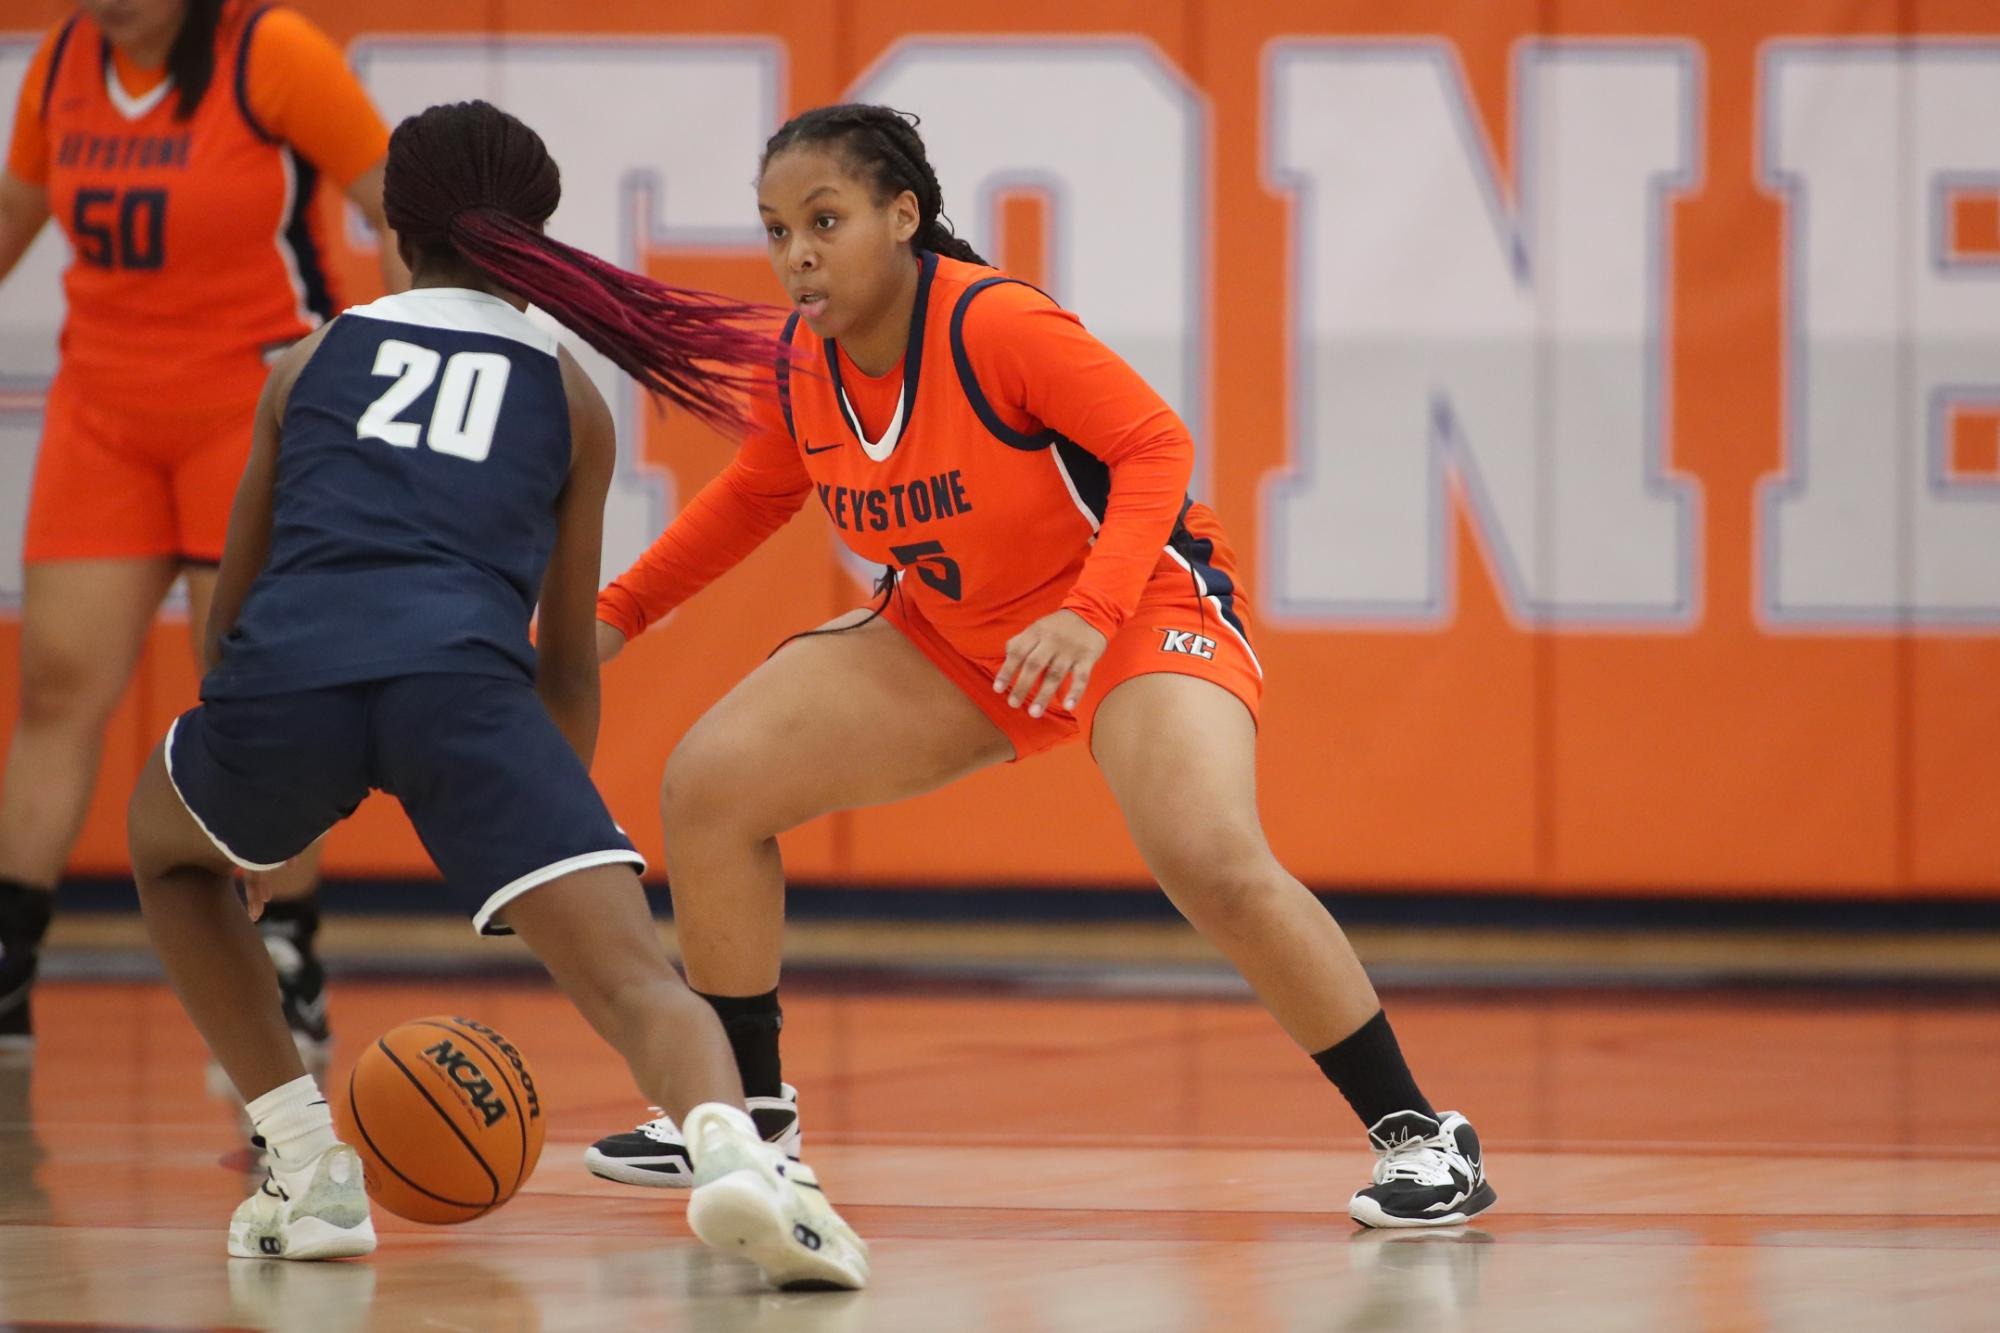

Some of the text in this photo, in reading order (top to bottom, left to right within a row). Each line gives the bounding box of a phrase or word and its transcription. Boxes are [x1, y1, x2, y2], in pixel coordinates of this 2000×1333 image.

[58, 129, 193, 170] KEYSTONE
[73, 187, 169, 270] 50
[356, 338, 512, 463] 20
[817, 469, 973, 532] KEYSTONE
[889, 540, 962, 602] 5
[423, 1039, 508, 1128] NCAA
